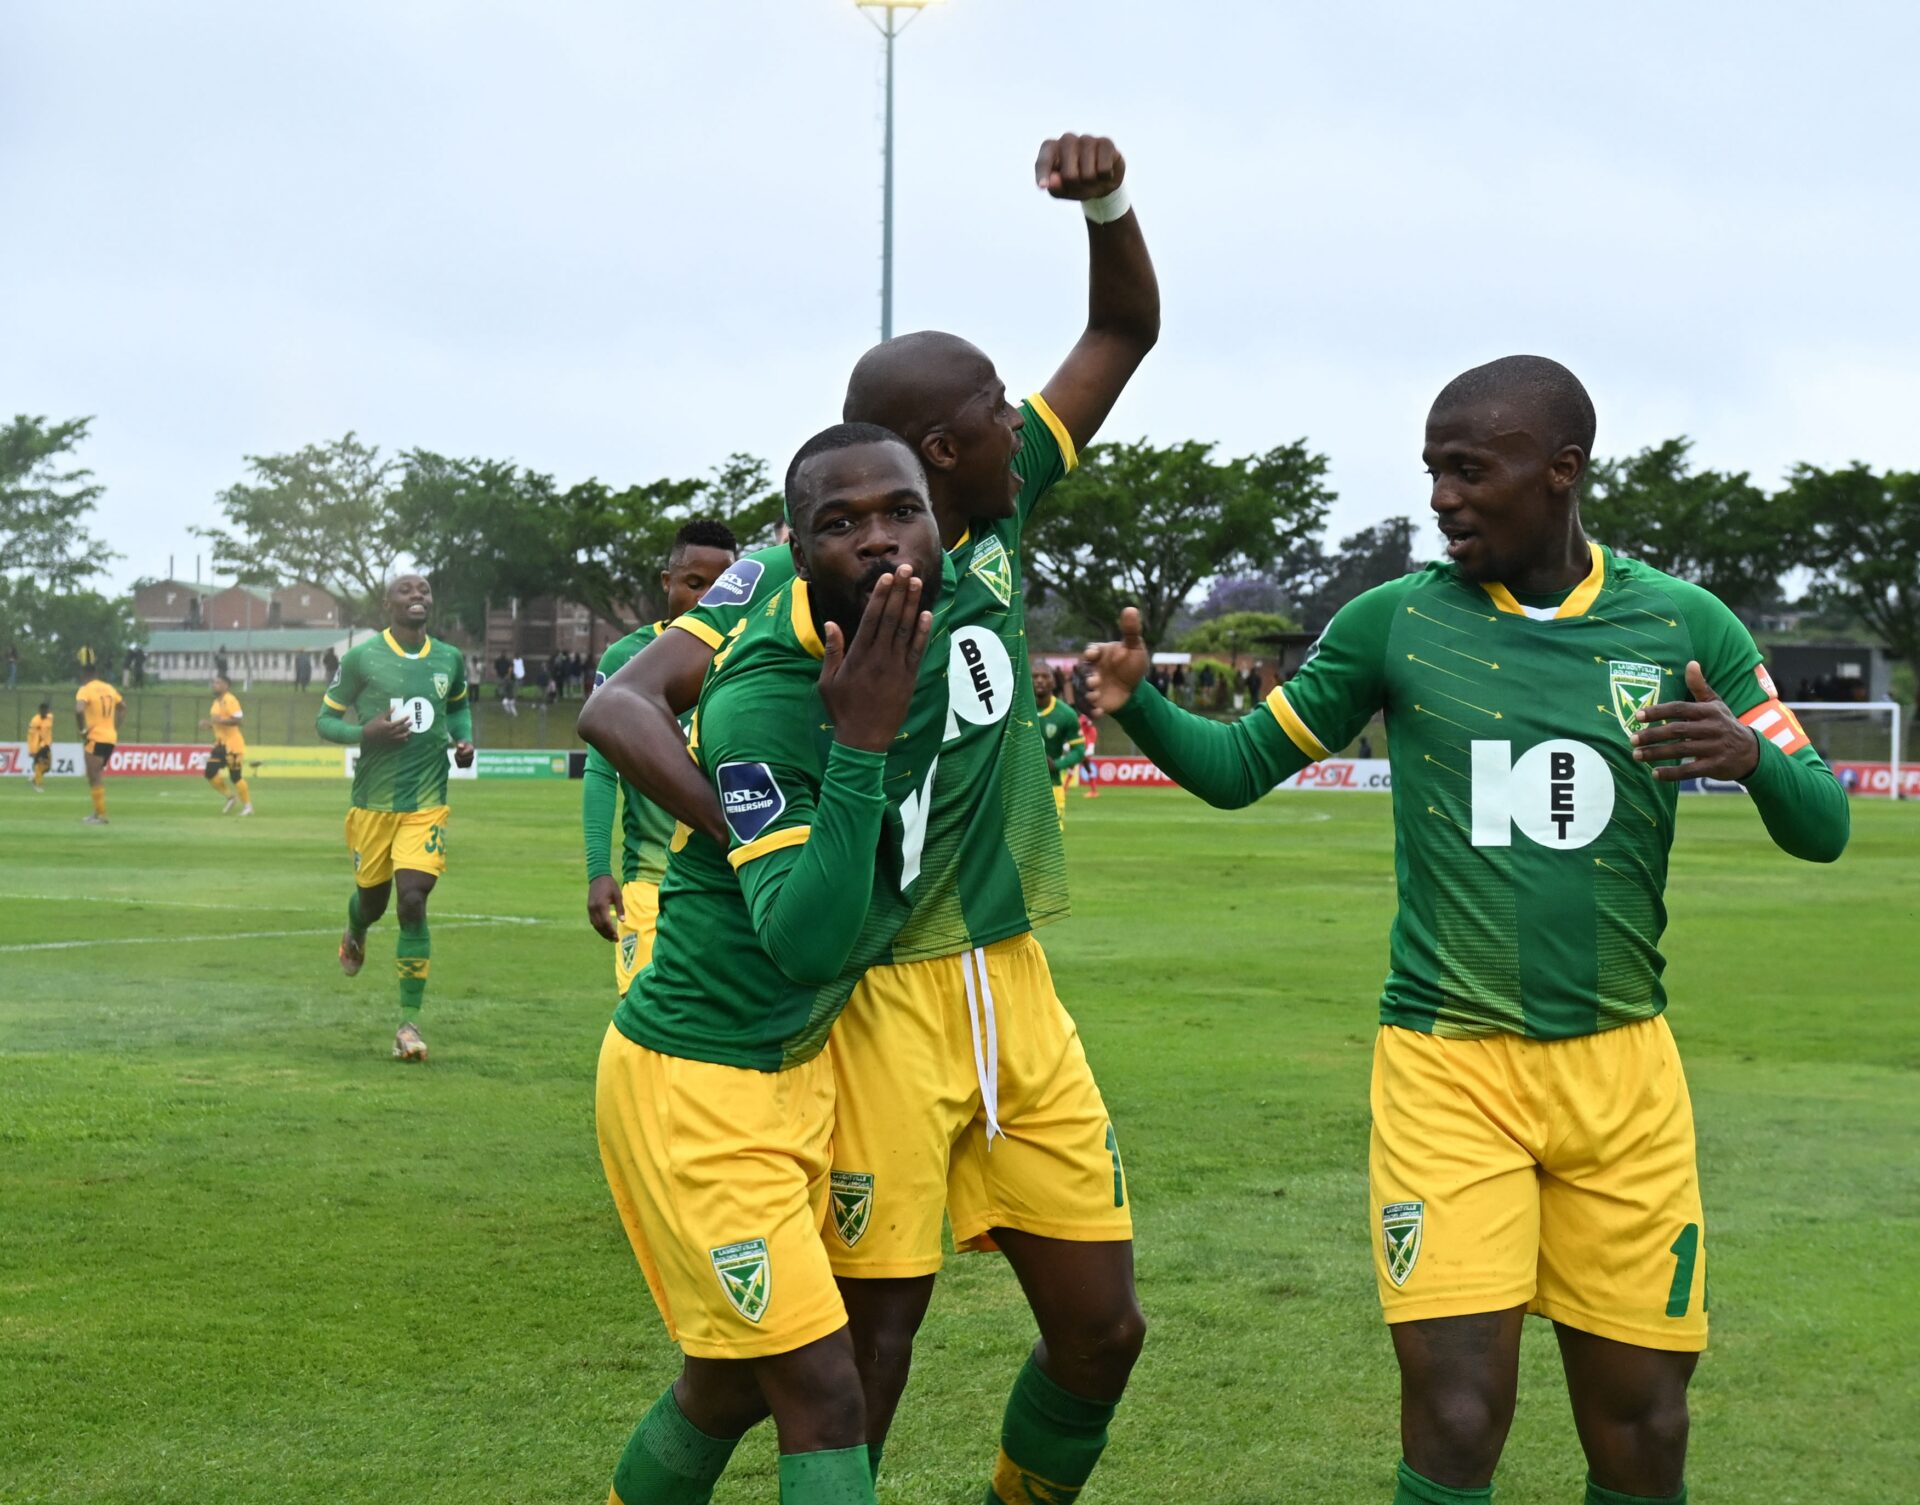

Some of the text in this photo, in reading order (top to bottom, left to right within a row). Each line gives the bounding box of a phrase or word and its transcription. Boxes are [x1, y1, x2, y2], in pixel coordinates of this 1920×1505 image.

[414, 701, 422, 730] BET
[958, 638, 995, 716] BET
[103, 751, 185, 771] OFFICIAL
[1295, 762, 1359, 787] PSL
[1471, 739, 1615, 850] 10
[1551, 752, 1575, 840] BET
[1665, 1222, 1709, 1317] 1
